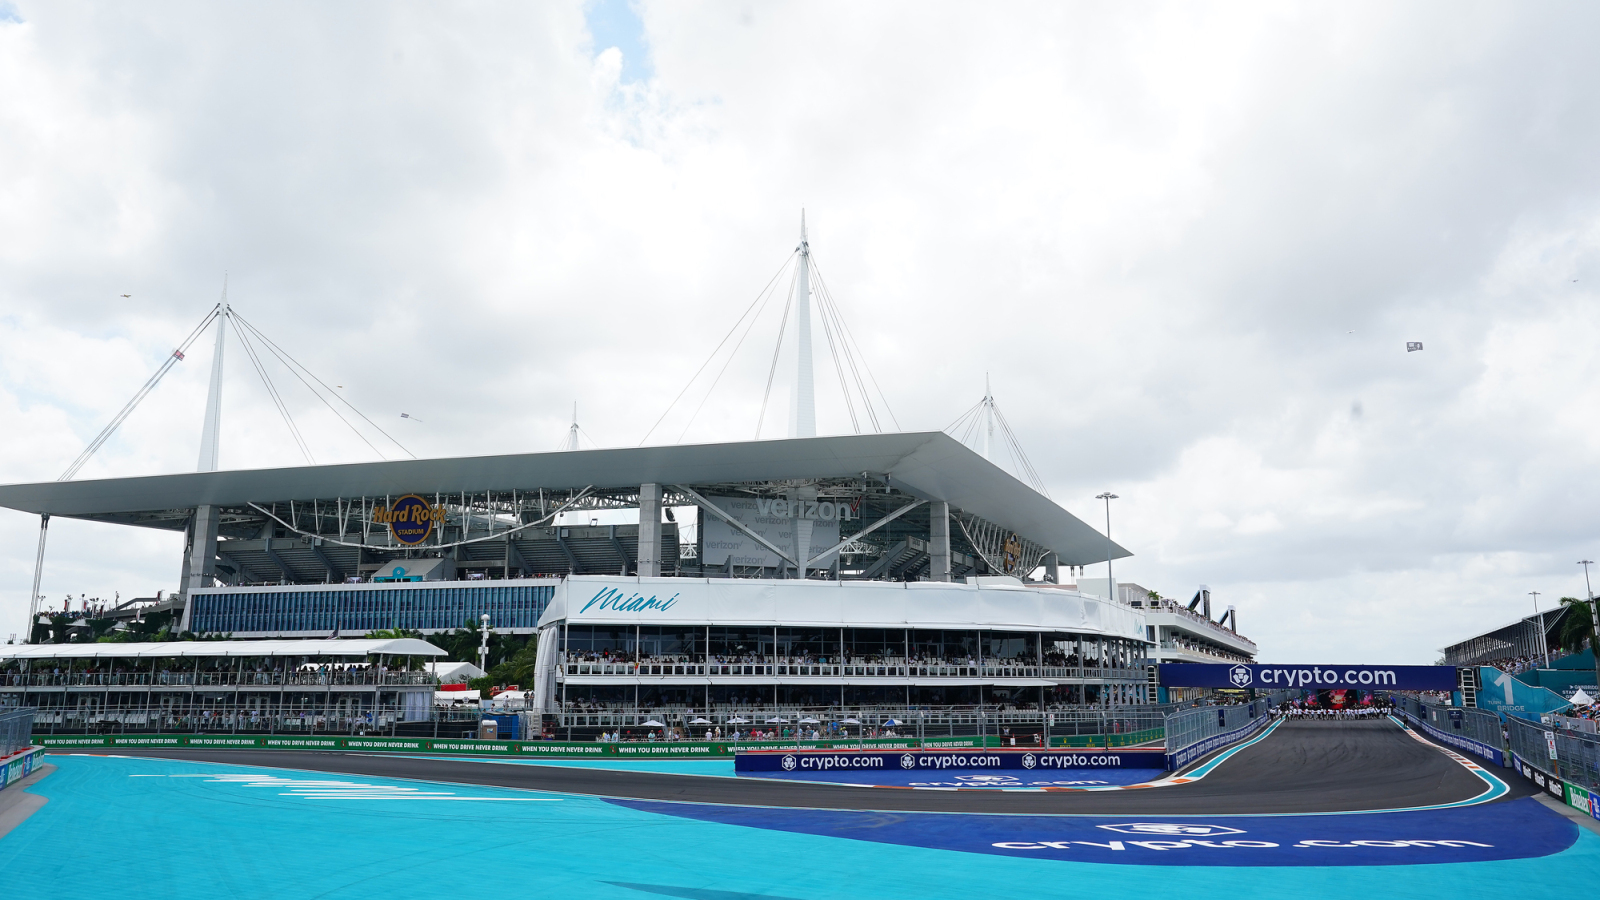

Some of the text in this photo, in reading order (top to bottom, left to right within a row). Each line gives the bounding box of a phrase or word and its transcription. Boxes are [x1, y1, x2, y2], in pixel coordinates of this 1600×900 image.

[731, 501, 758, 510] verizo
[756, 498, 851, 521] verizon
[373, 504, 446, 525] Hard Rock
[755, 516, 787, 525] verizon
[706, 541, 740, 549] verizon
[580, 586, 680, 614] Miami
[1260, 666, 1397, 687] crypto.com
[801, 755, 883, 769] crypto.com
[919, 754, 1001, 768] crypto.com
[1040, 754, 1121, 768] crypto.com
[992, 839, 1495, 851] crypto.com
